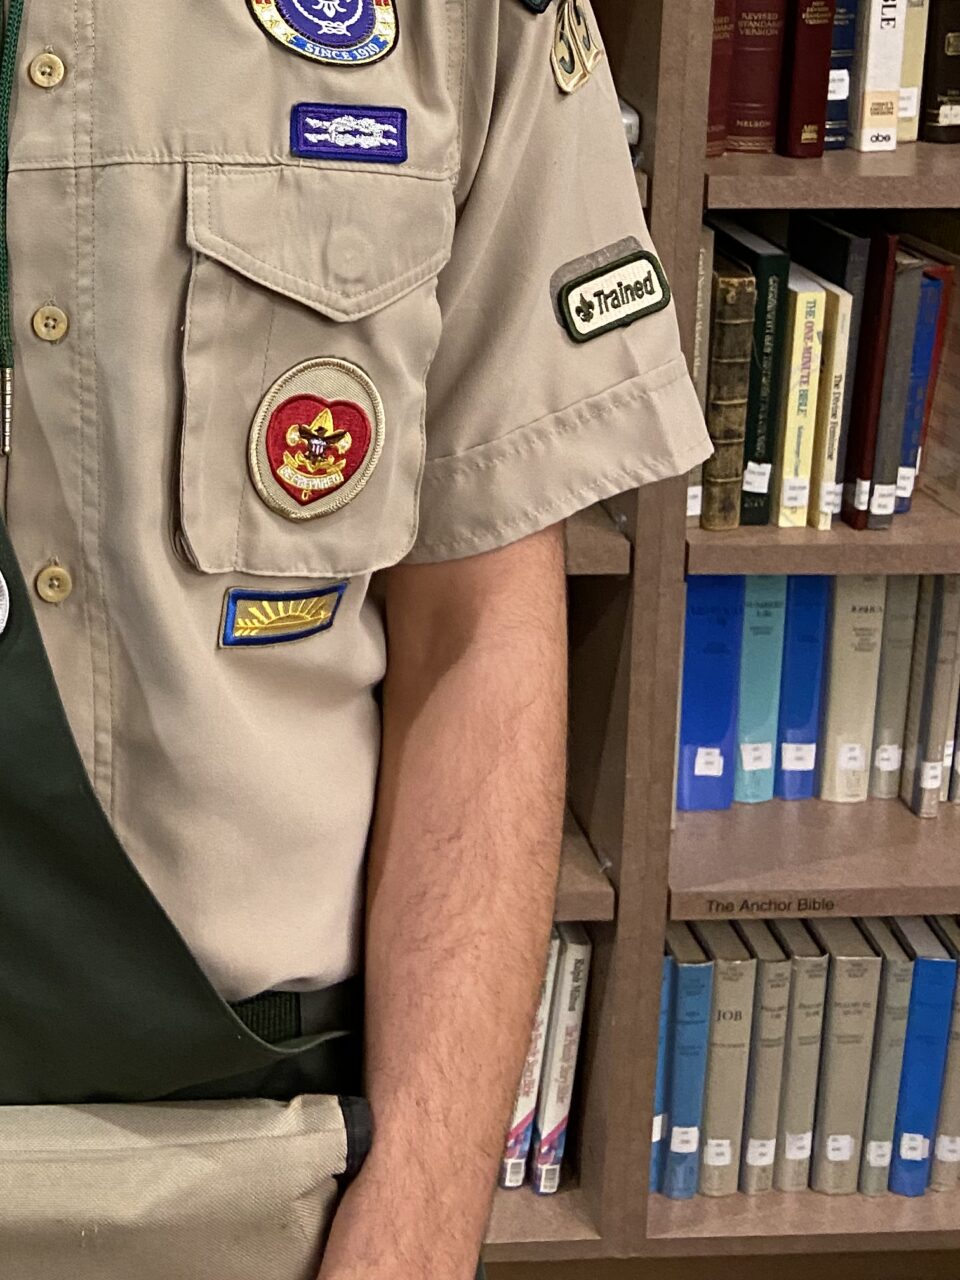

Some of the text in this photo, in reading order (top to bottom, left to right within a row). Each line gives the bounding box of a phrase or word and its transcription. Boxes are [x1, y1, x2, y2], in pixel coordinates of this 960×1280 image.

[305, 42, 380, 61] SINCE 1910
[593, 270, 656, 315] Trained
[805, 299, 817, 319] THE
[800, 320, 815, 386] ONE-MINUTE
[834, 374, 843, 389] The
[797, 389, 809, 417] BIBLE
[831, 391, 842, 419] Divine
[708, 897, 835, 913] The Anchor Bible
[716, 1009, 743, 1022] JOB
